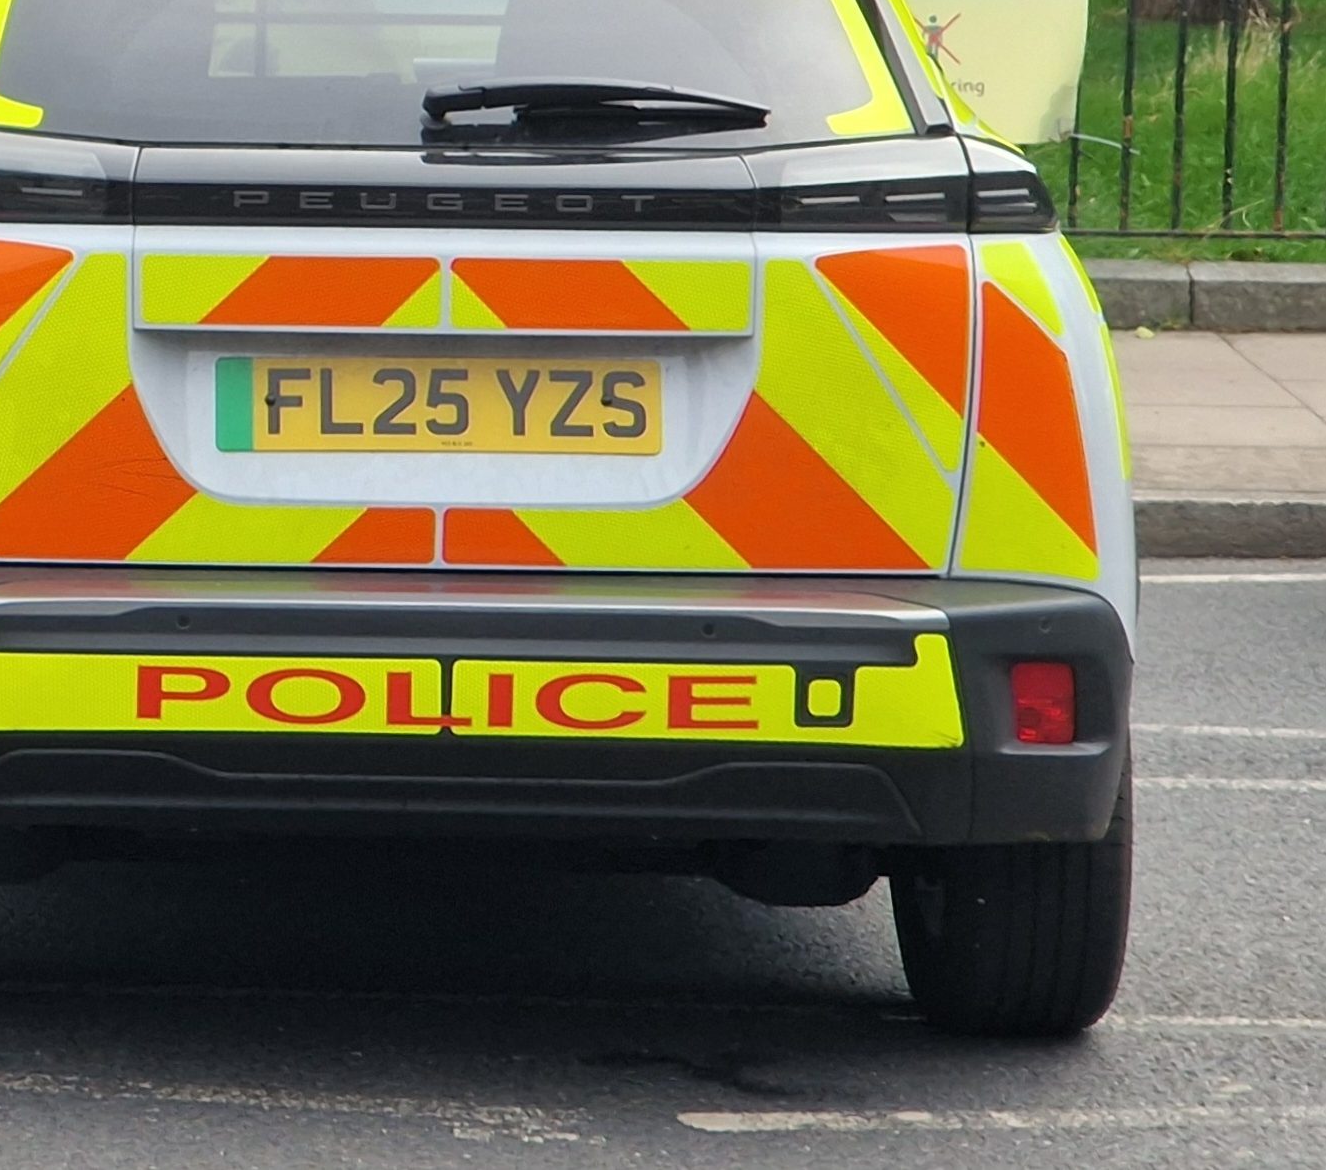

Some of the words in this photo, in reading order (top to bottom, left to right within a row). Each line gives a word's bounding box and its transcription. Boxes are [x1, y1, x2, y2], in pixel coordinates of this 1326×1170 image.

[233, 190, 656, 215] PEUGEOT
[266, 367, 469, 436] FL25
[495, 369, 648, 438] YZS
[136, 664, 759, 730] POLICE
